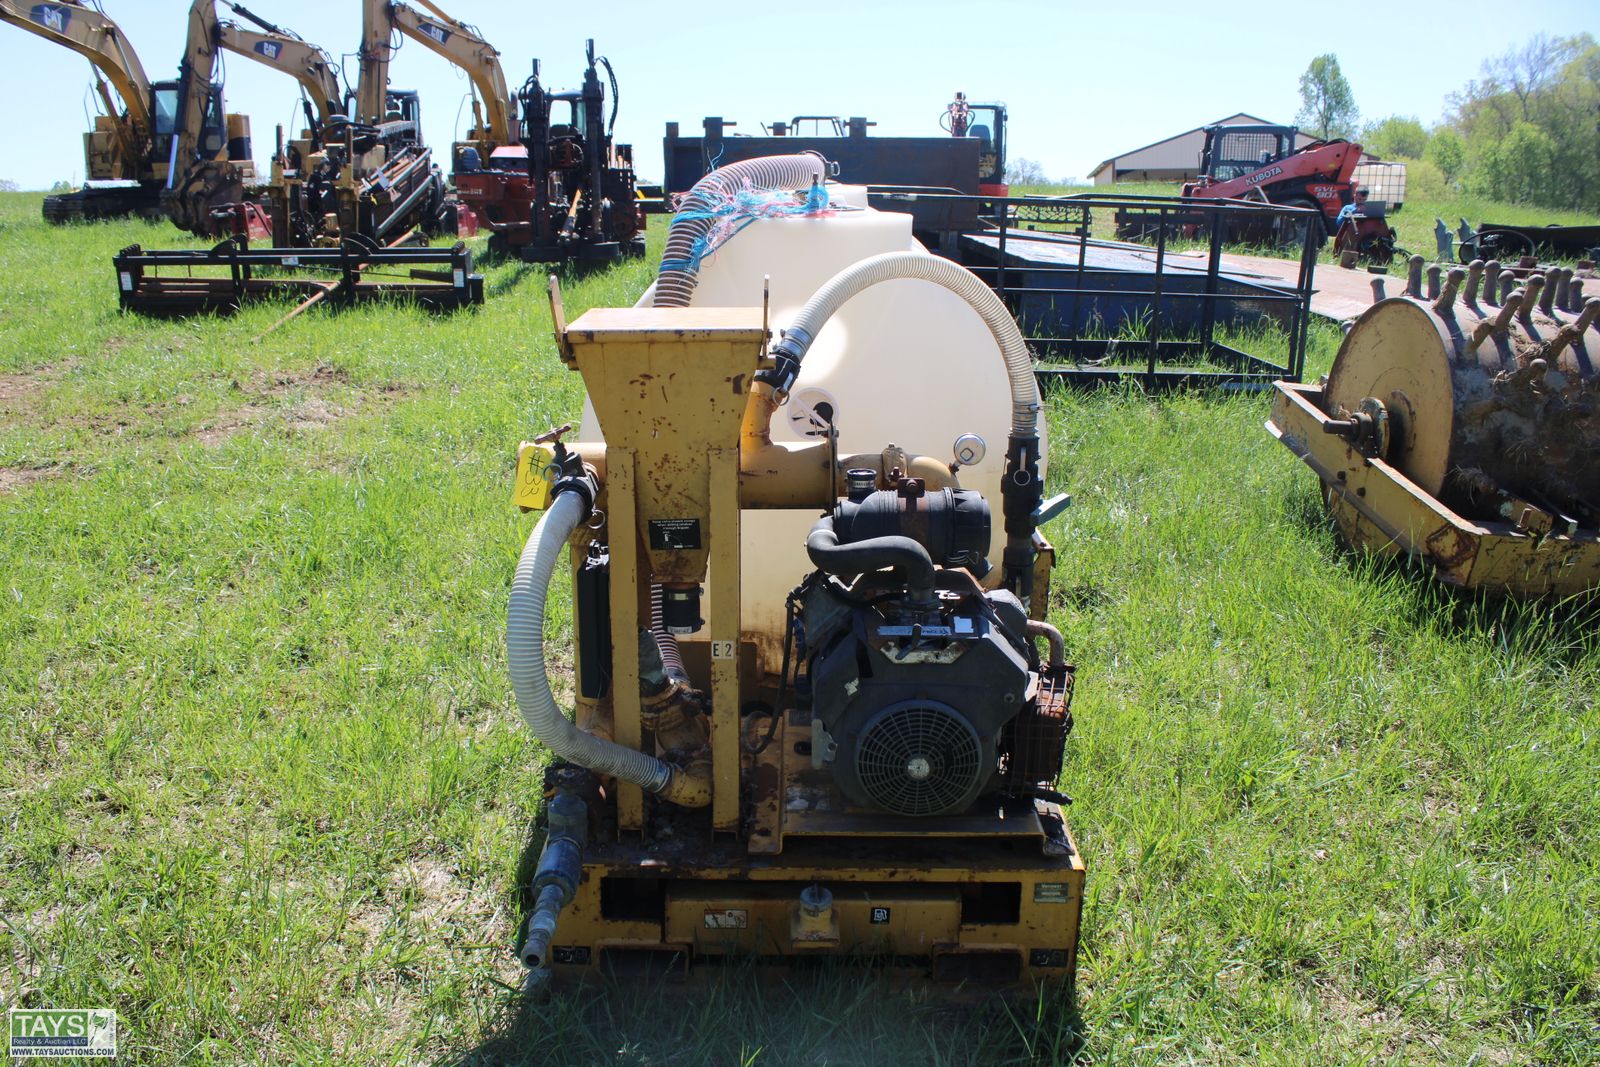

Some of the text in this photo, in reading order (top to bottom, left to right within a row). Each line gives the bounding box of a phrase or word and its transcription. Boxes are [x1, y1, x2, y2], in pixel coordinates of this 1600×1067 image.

[43, 6, 63, 32] CAT
[431, 26, 444, 43] CAT
[263, 42, 277, 58] CAT
[1245, 167, 1282, 186] KUBOTA
